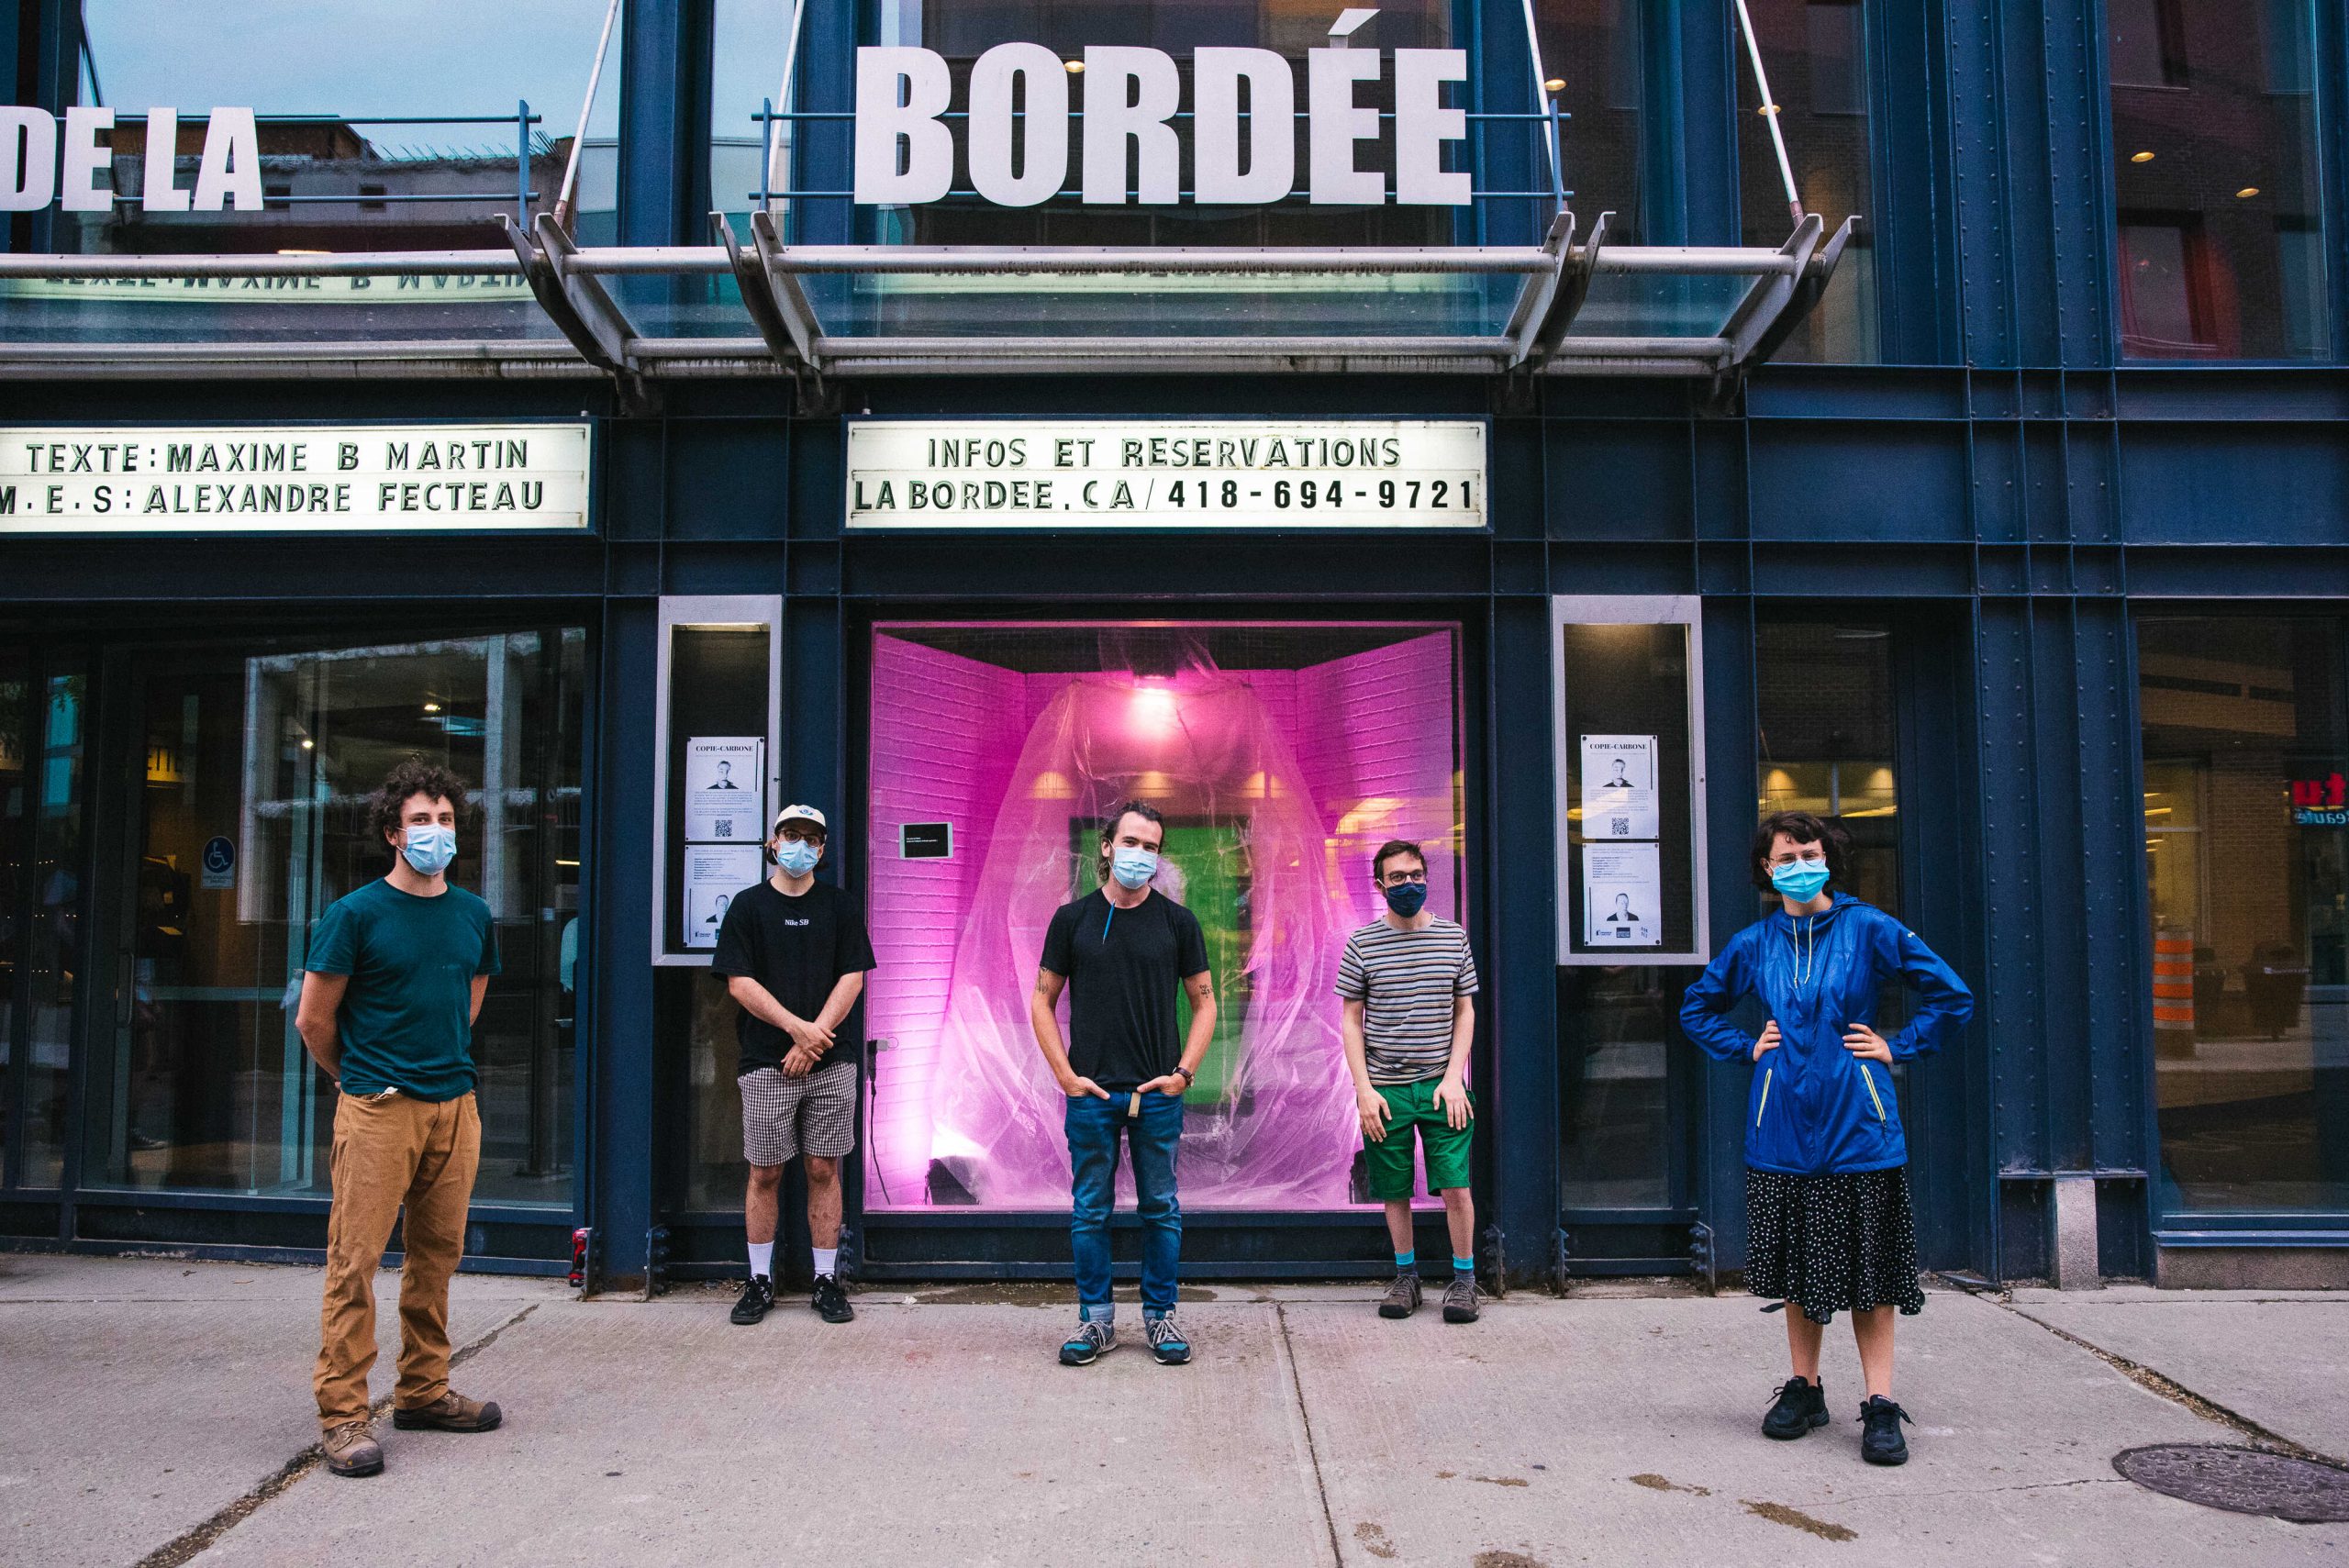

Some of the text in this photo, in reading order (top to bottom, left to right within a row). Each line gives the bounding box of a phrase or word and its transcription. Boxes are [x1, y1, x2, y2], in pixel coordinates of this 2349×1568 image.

[853, 8, 1472, 206] BORDÉE
[0, 106, 264, 211] DE LA
[337, 441, 359, 471] B
[385, 439, 528, 471] MARTIN
[928, 437, 1401, 468] INFOS ET RESERVATIONS
[378, 481, 543, 512] FECTEAU
[785, 918, 798, 927] Nike
